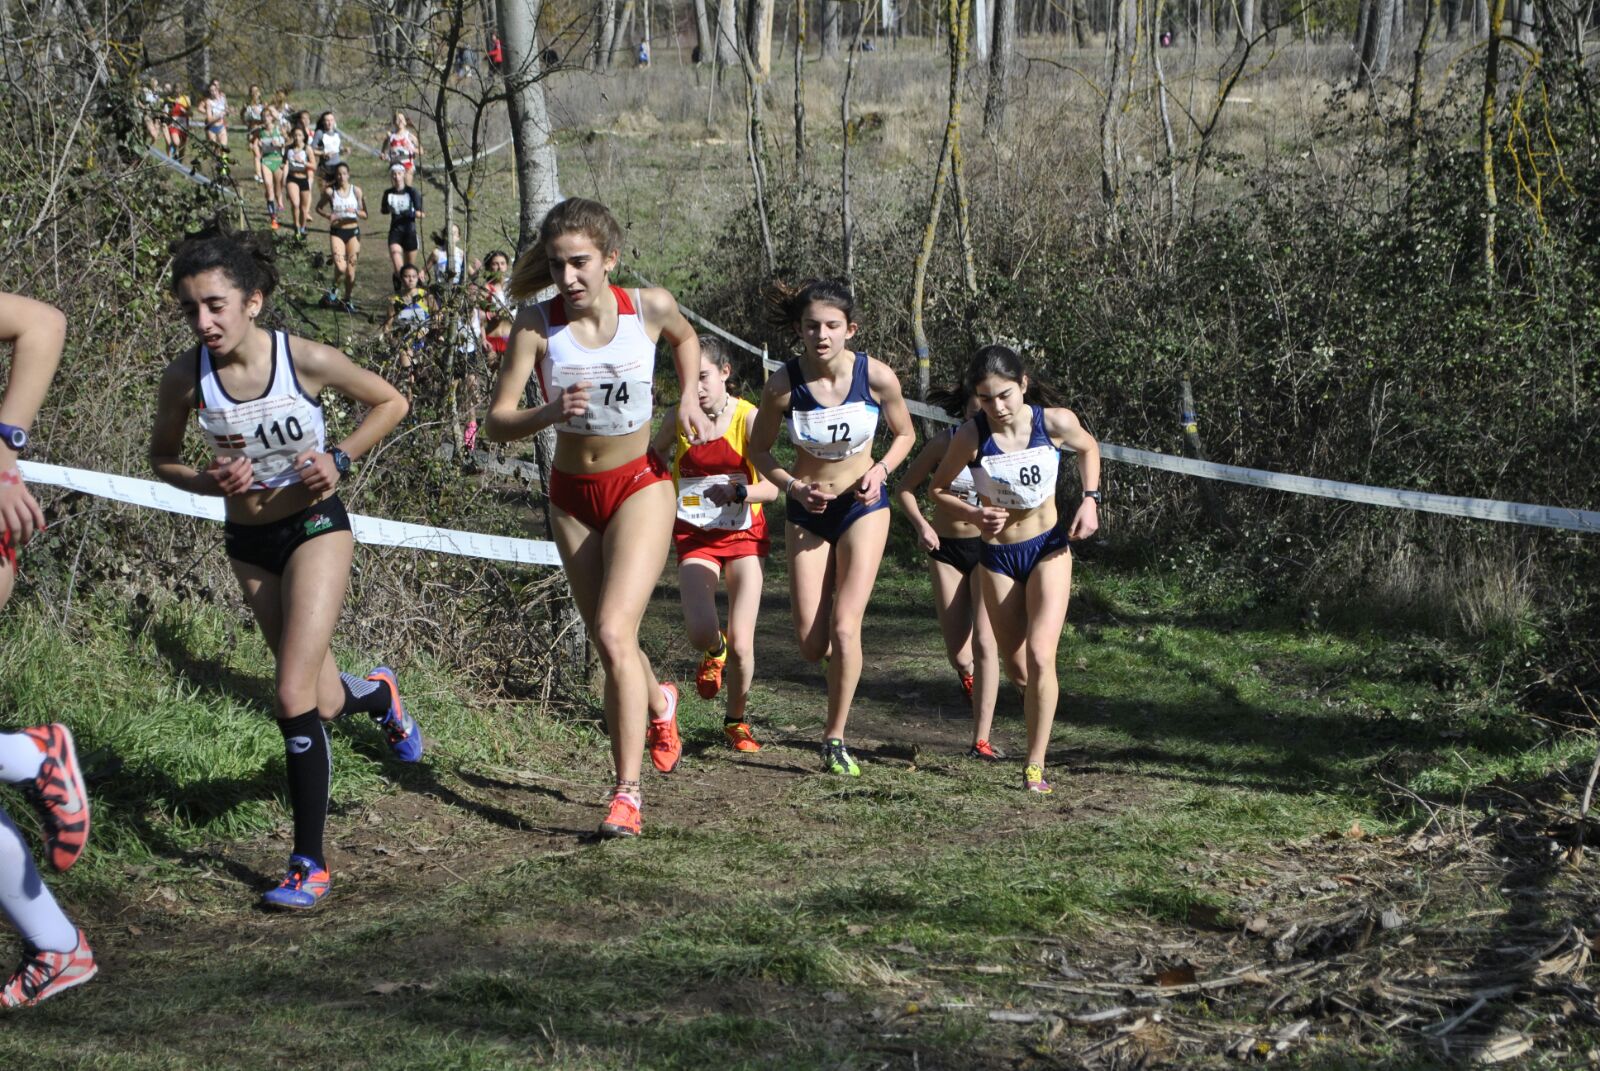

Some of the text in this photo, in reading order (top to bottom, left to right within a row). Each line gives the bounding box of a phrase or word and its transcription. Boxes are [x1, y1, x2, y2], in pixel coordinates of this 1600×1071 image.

[600, 381, 630, 406] 74
[254, 416, 303, 449] 110
[827, 422, 852, 443] 72
[1019, 464, 1042, 486] 68
